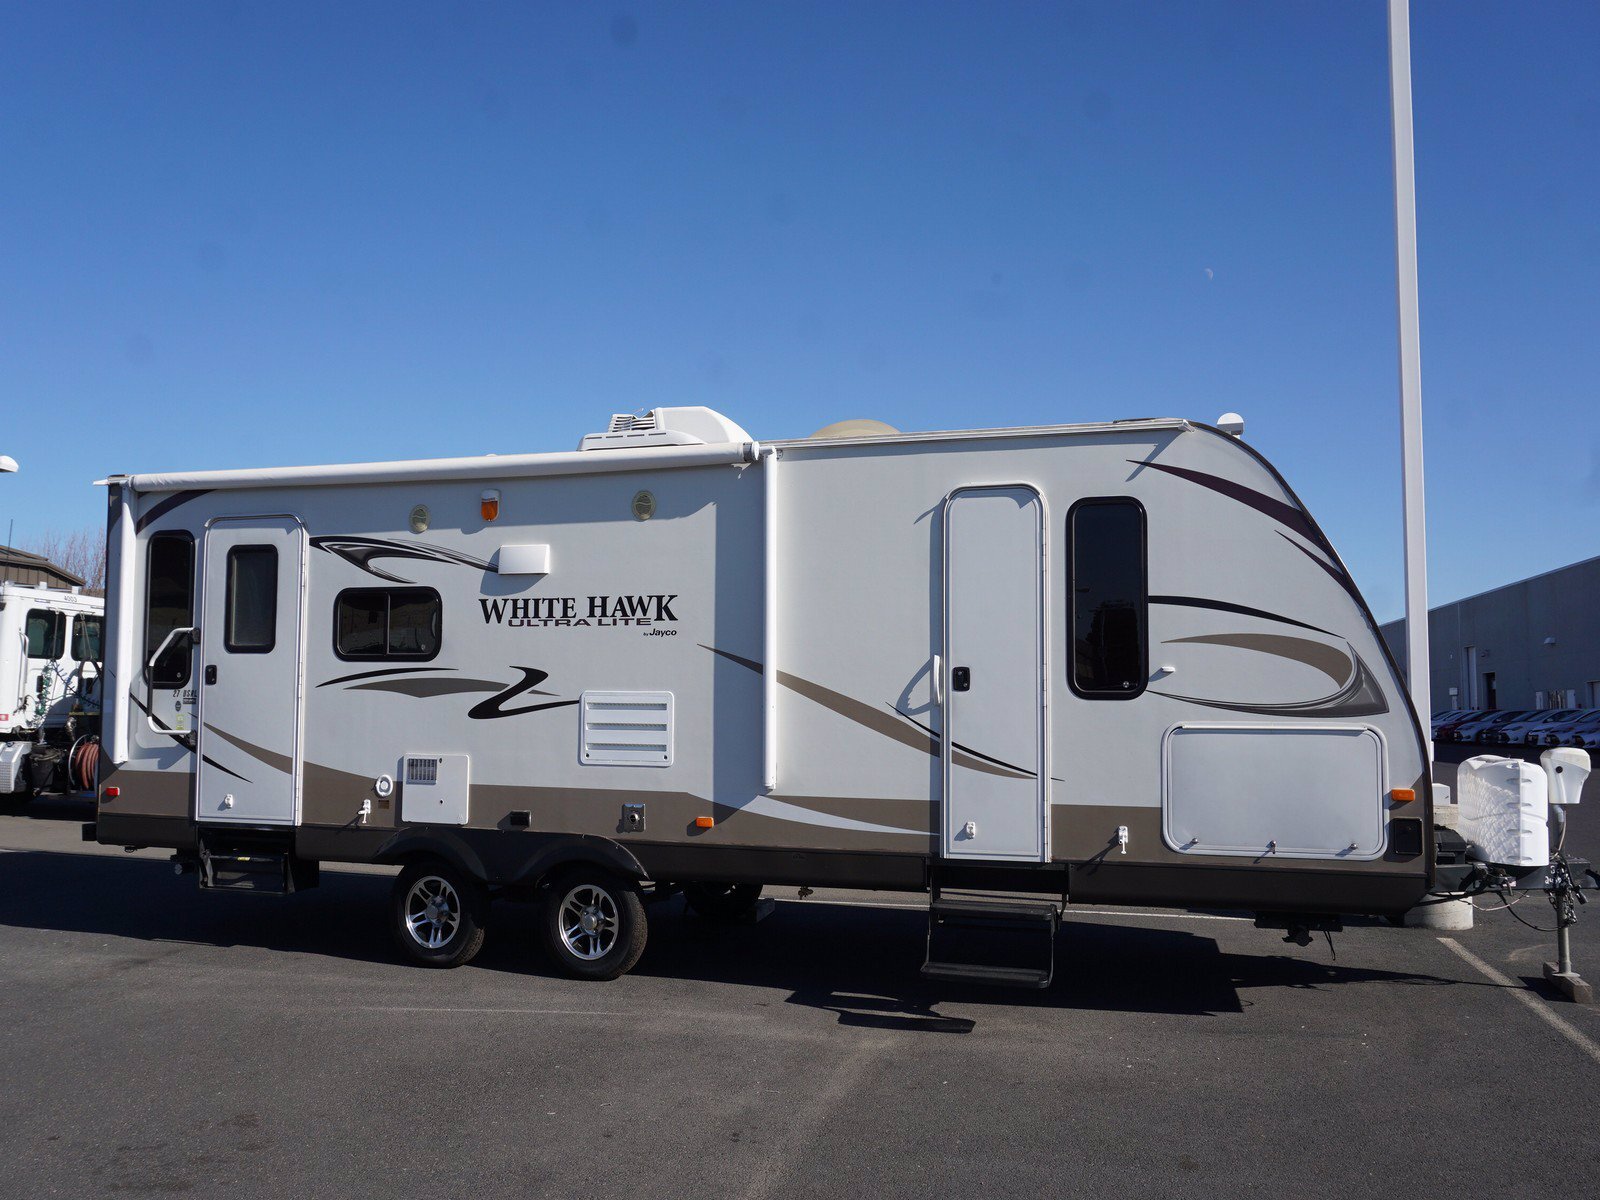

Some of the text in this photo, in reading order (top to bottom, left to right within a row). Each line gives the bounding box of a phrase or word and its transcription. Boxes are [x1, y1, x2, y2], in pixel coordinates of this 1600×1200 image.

[478, 594, 679, 624] WHITE HAWK
[508, 617, 652, 627] ULTRA LITE
[649, 627, 677, 638] Jayco
[172, 690, 180, 698] 27
